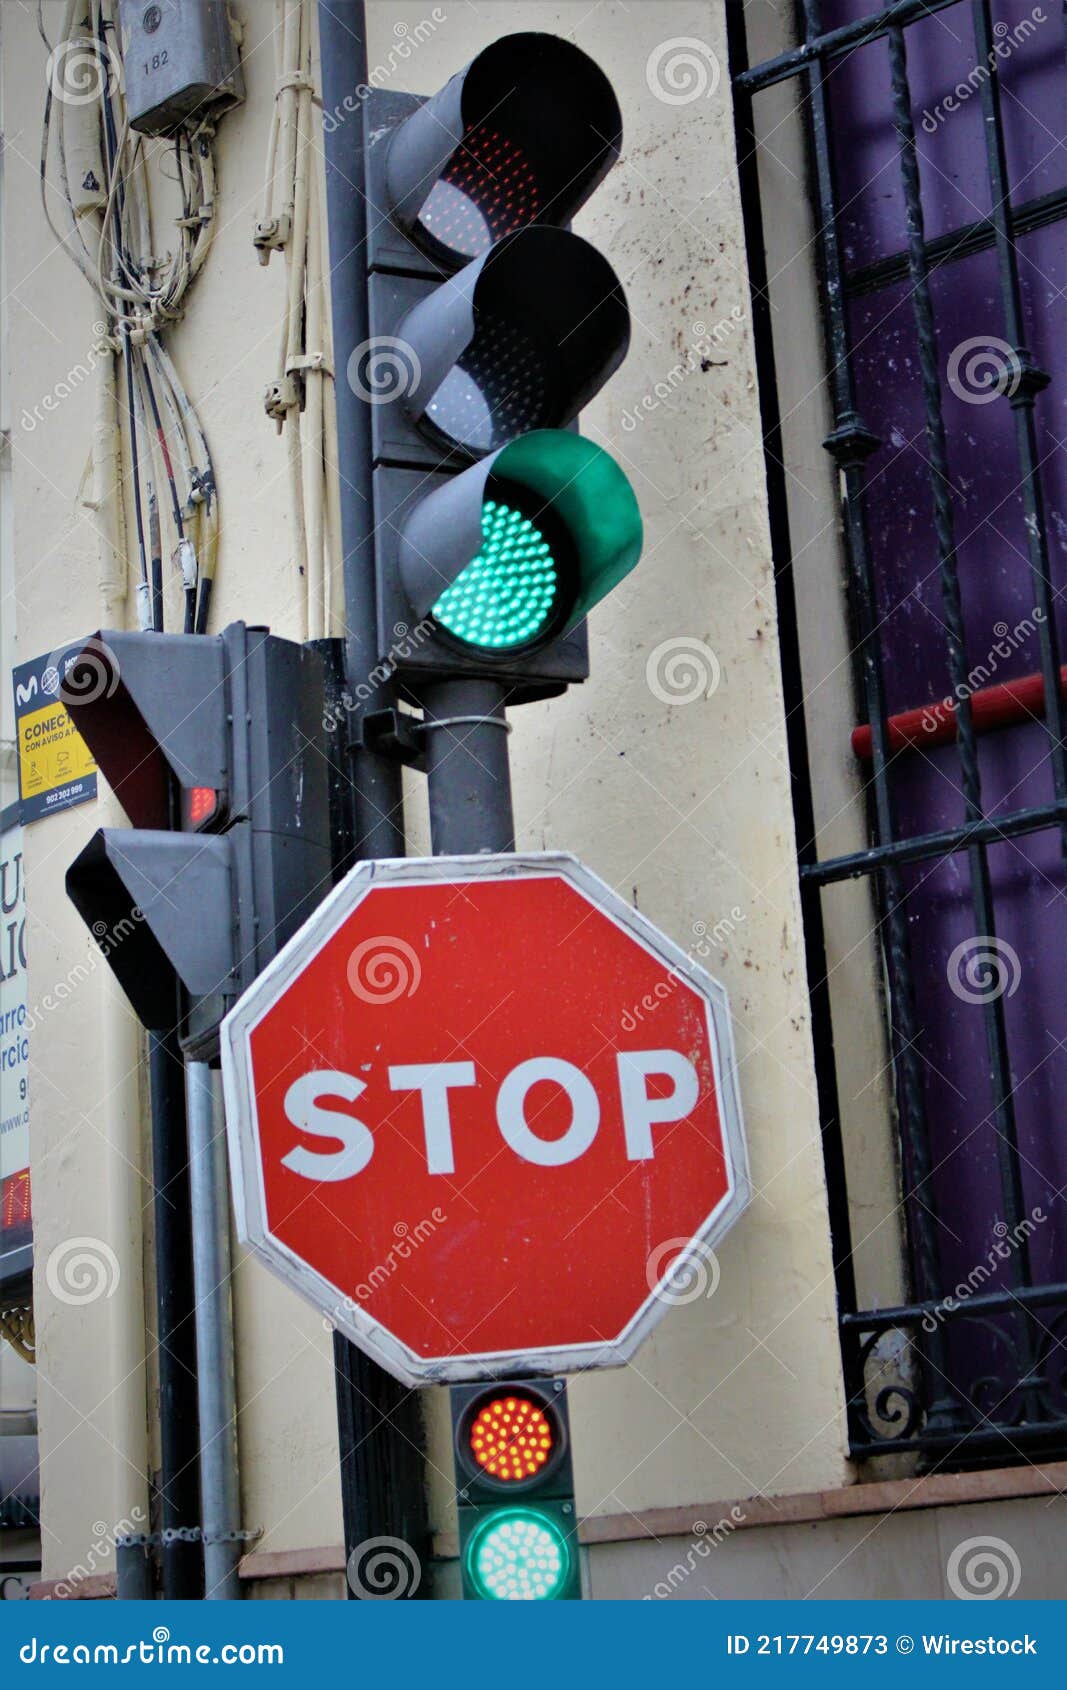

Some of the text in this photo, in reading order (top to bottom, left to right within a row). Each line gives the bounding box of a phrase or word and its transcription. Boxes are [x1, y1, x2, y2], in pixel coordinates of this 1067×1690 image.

[143, 50, 169, 75] 182
[25, 741, 40, 752] CON
[42, 731, 64, 746] AVISO
[0, 852, 25, 914] U
[280, 1048, 699, 1182] STOP
